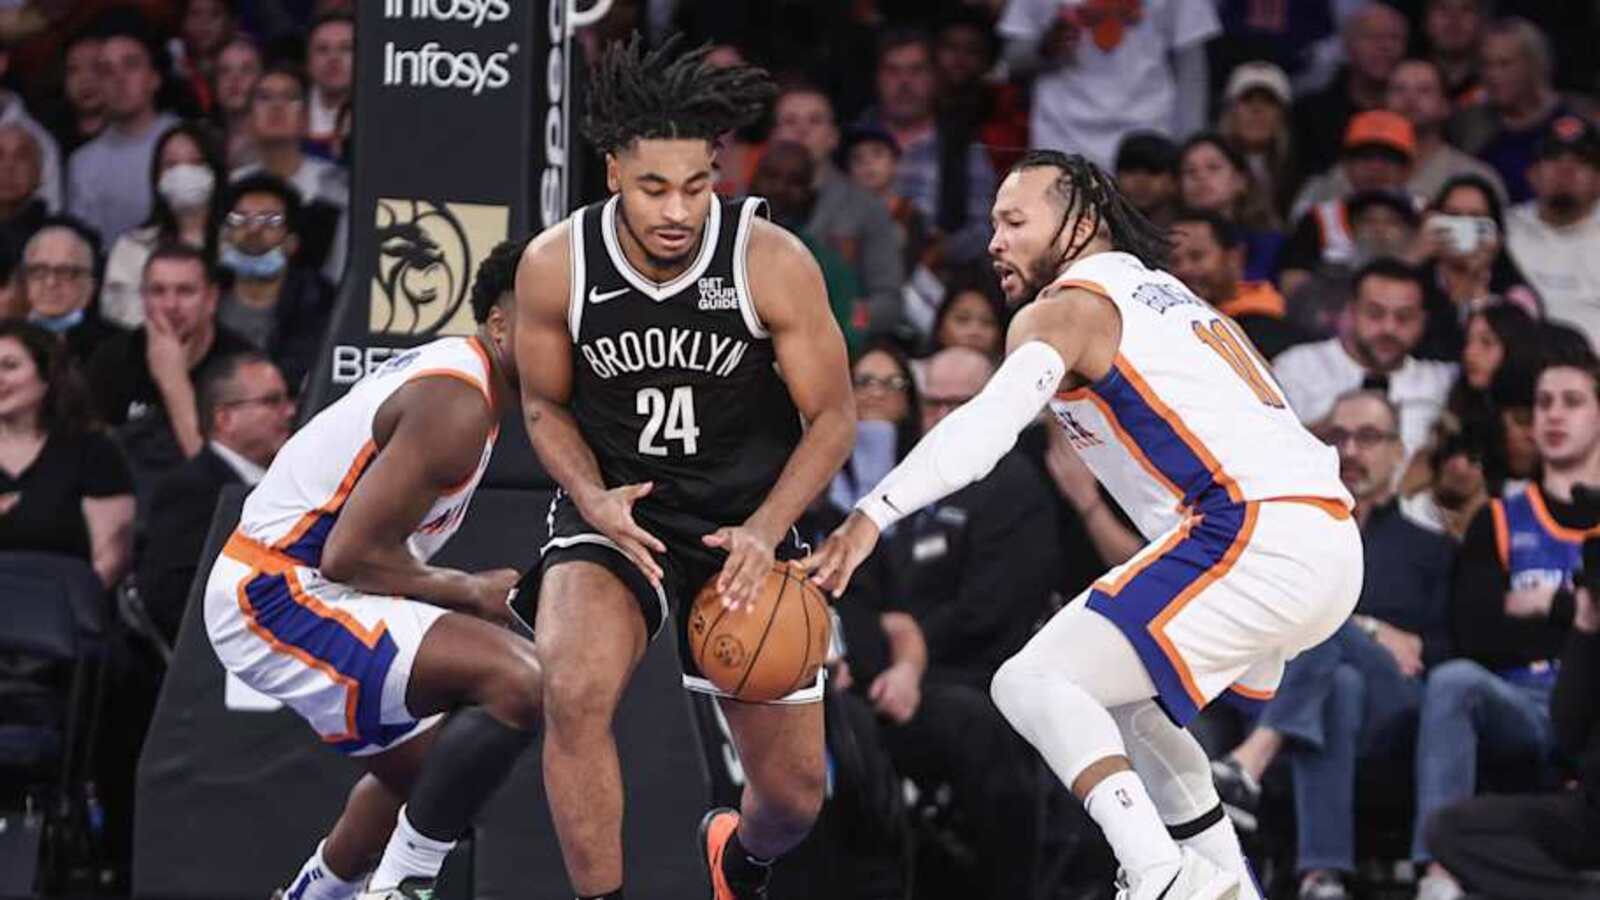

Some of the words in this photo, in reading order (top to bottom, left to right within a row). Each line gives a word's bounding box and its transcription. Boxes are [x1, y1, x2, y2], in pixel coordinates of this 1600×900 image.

[384, 41, 510, 95] Infosys
[698, 277, 724, 289] GET
[698, 299, 738, 310] GUIDE
[699, 287, 737, 301] YOUR
[331, 345, 408, 383] BE
[581, 328, 749, 379] BROOKLYN
[1192, 318, 1286, 409] 11
[636, 385, 700, 456] 24
